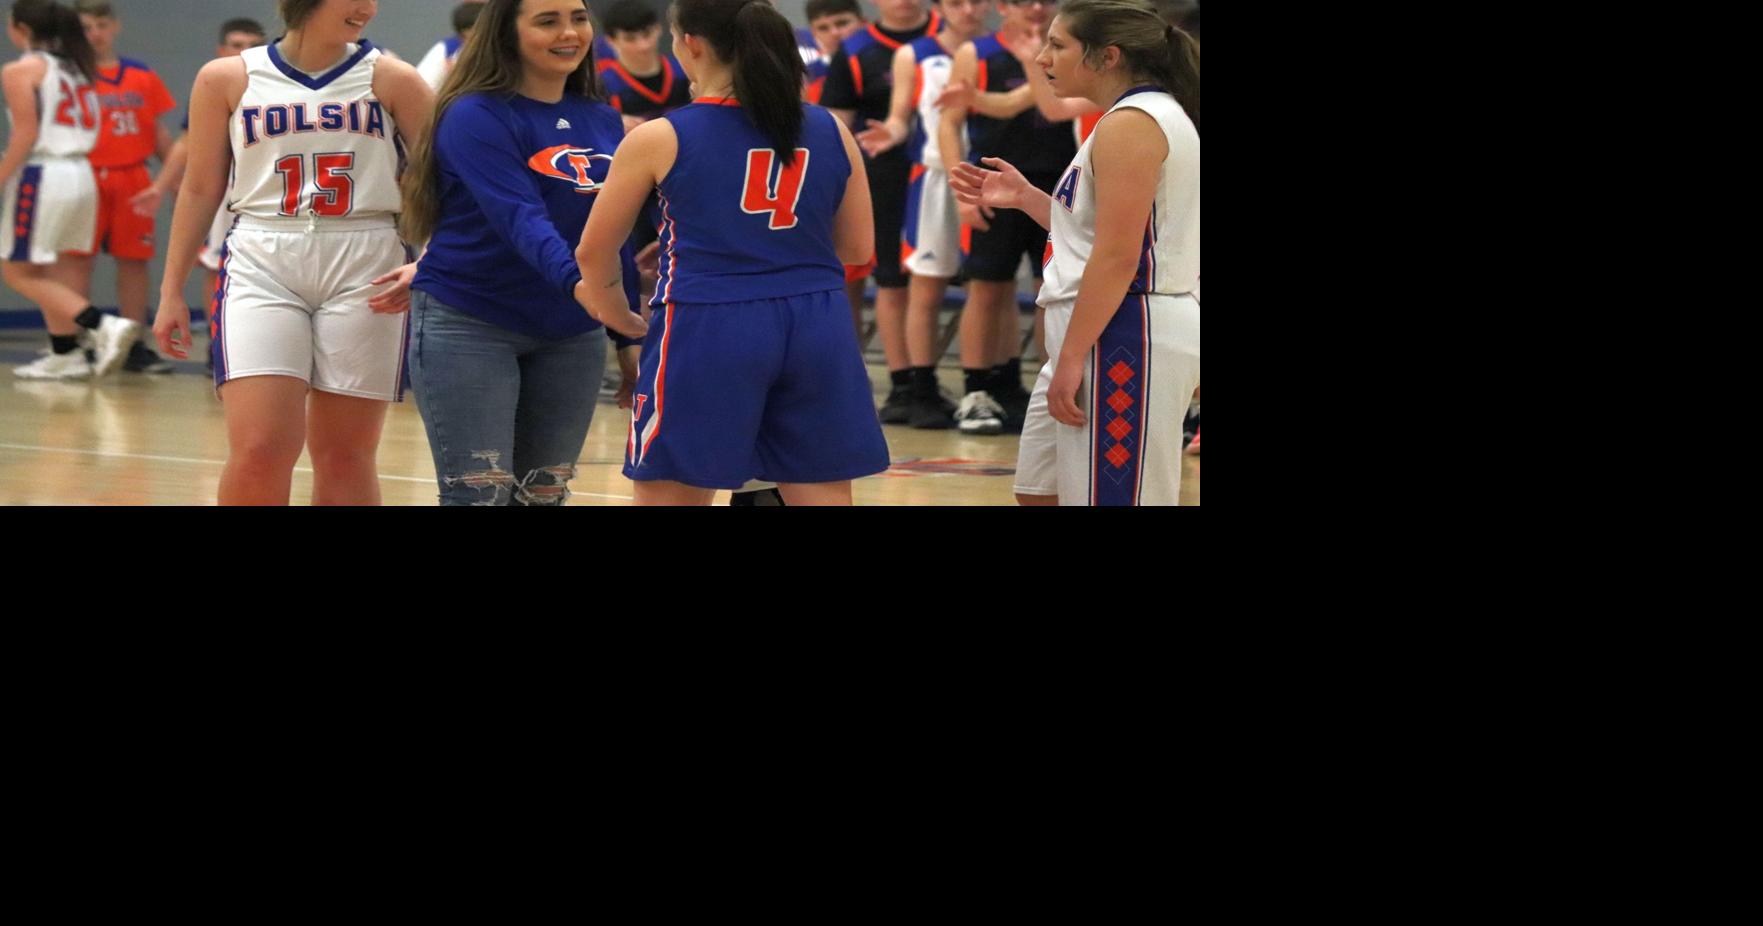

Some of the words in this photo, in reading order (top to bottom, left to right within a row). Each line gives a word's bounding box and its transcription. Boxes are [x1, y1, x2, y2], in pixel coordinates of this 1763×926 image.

[241, 99, 386, 148] TOLSIA
[275, 152, 355, 217] 15
[740, 147, 810, 230] 4
